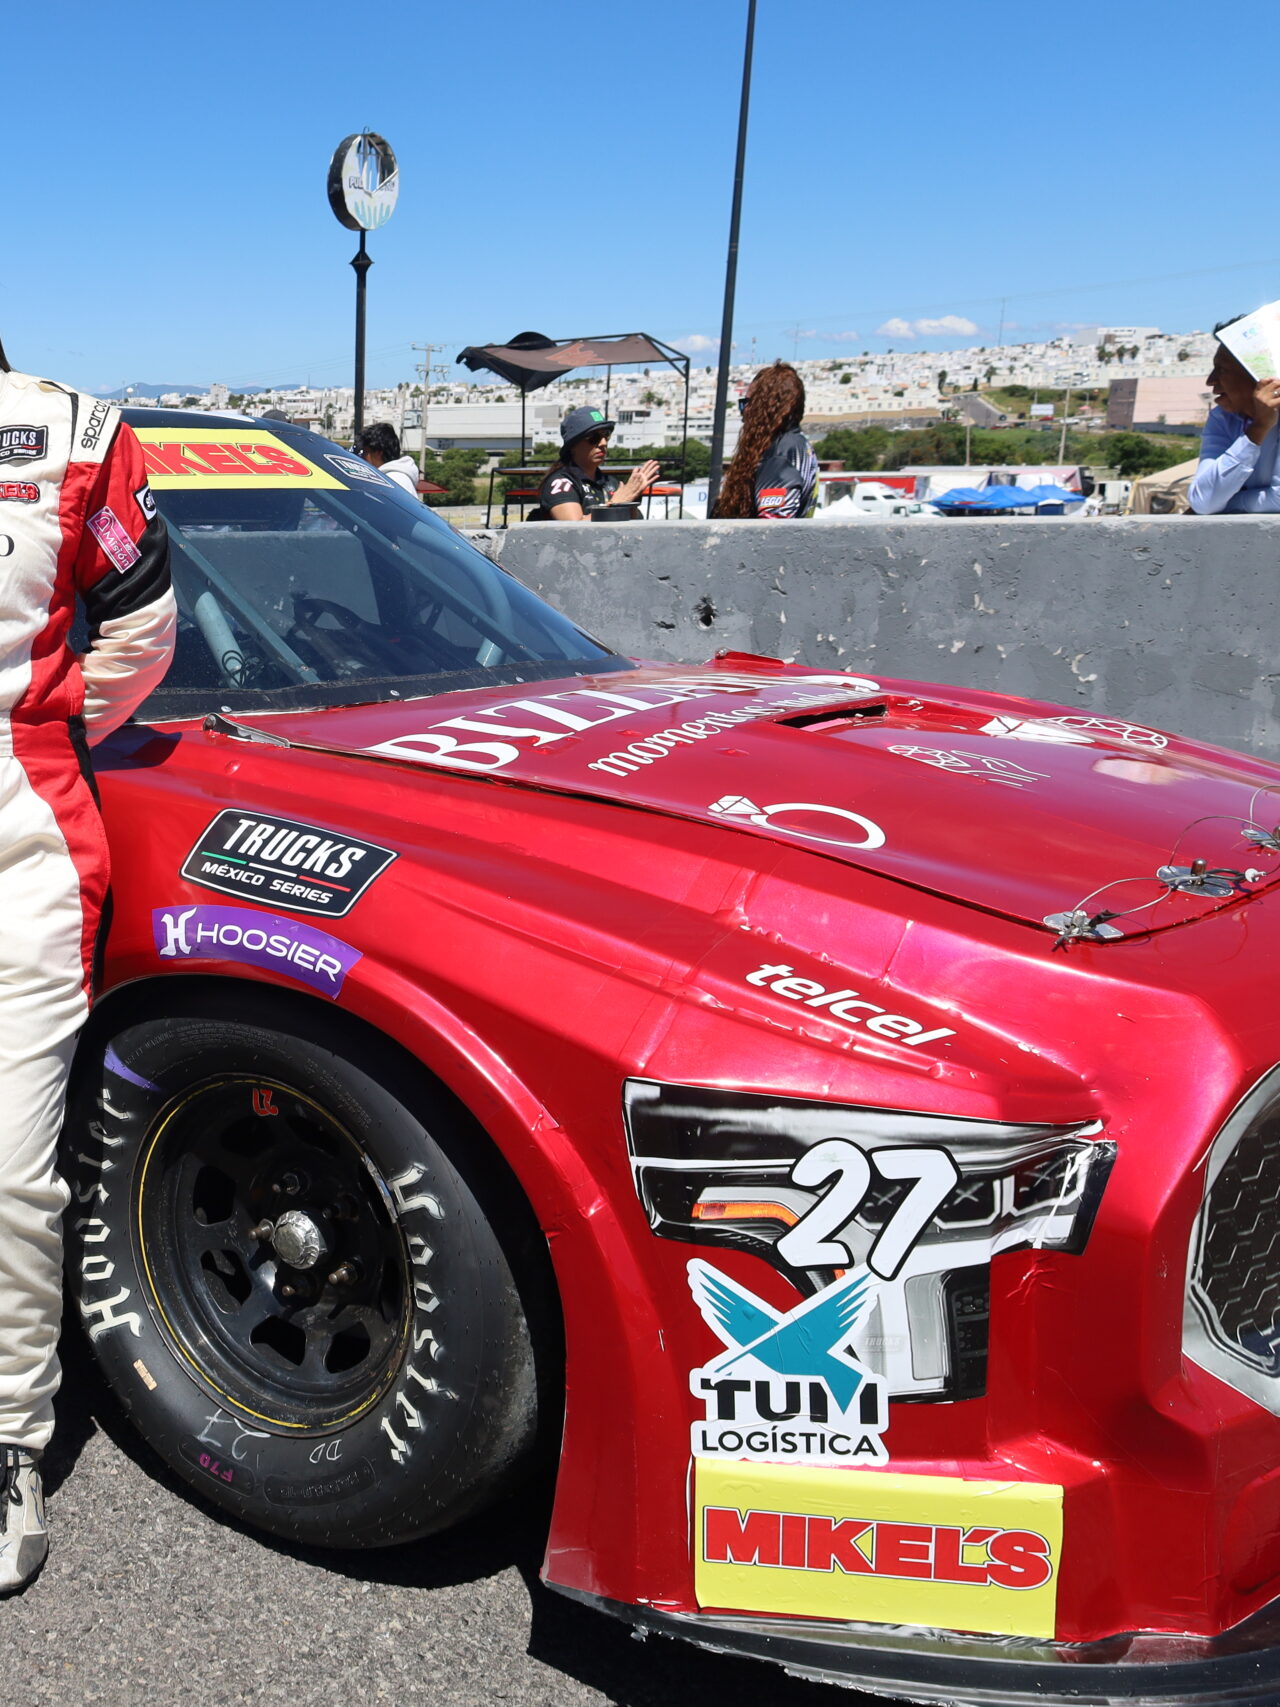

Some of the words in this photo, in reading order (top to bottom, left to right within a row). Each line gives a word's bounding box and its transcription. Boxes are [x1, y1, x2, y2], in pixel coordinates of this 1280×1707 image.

[140, 441, 312, 476] IKEL'S
[550, 478, 574, 494] 27
[760, 496, 783, 507] LEGO
[223, 818, 367, 879] TRUCKS
[201, 861, 265, 886] MÉXICO
[269, 878, 333, 904] SERIES
[196, 922, 342, 982] HOOSIER
[745, 962, 957, 1047] telcel
[773, 1137, 963, 1281] 27
[701, 1425, 879, 1457] LOGÍSTICA
[702, 1505, 1053, 1591] MIKEL'S
